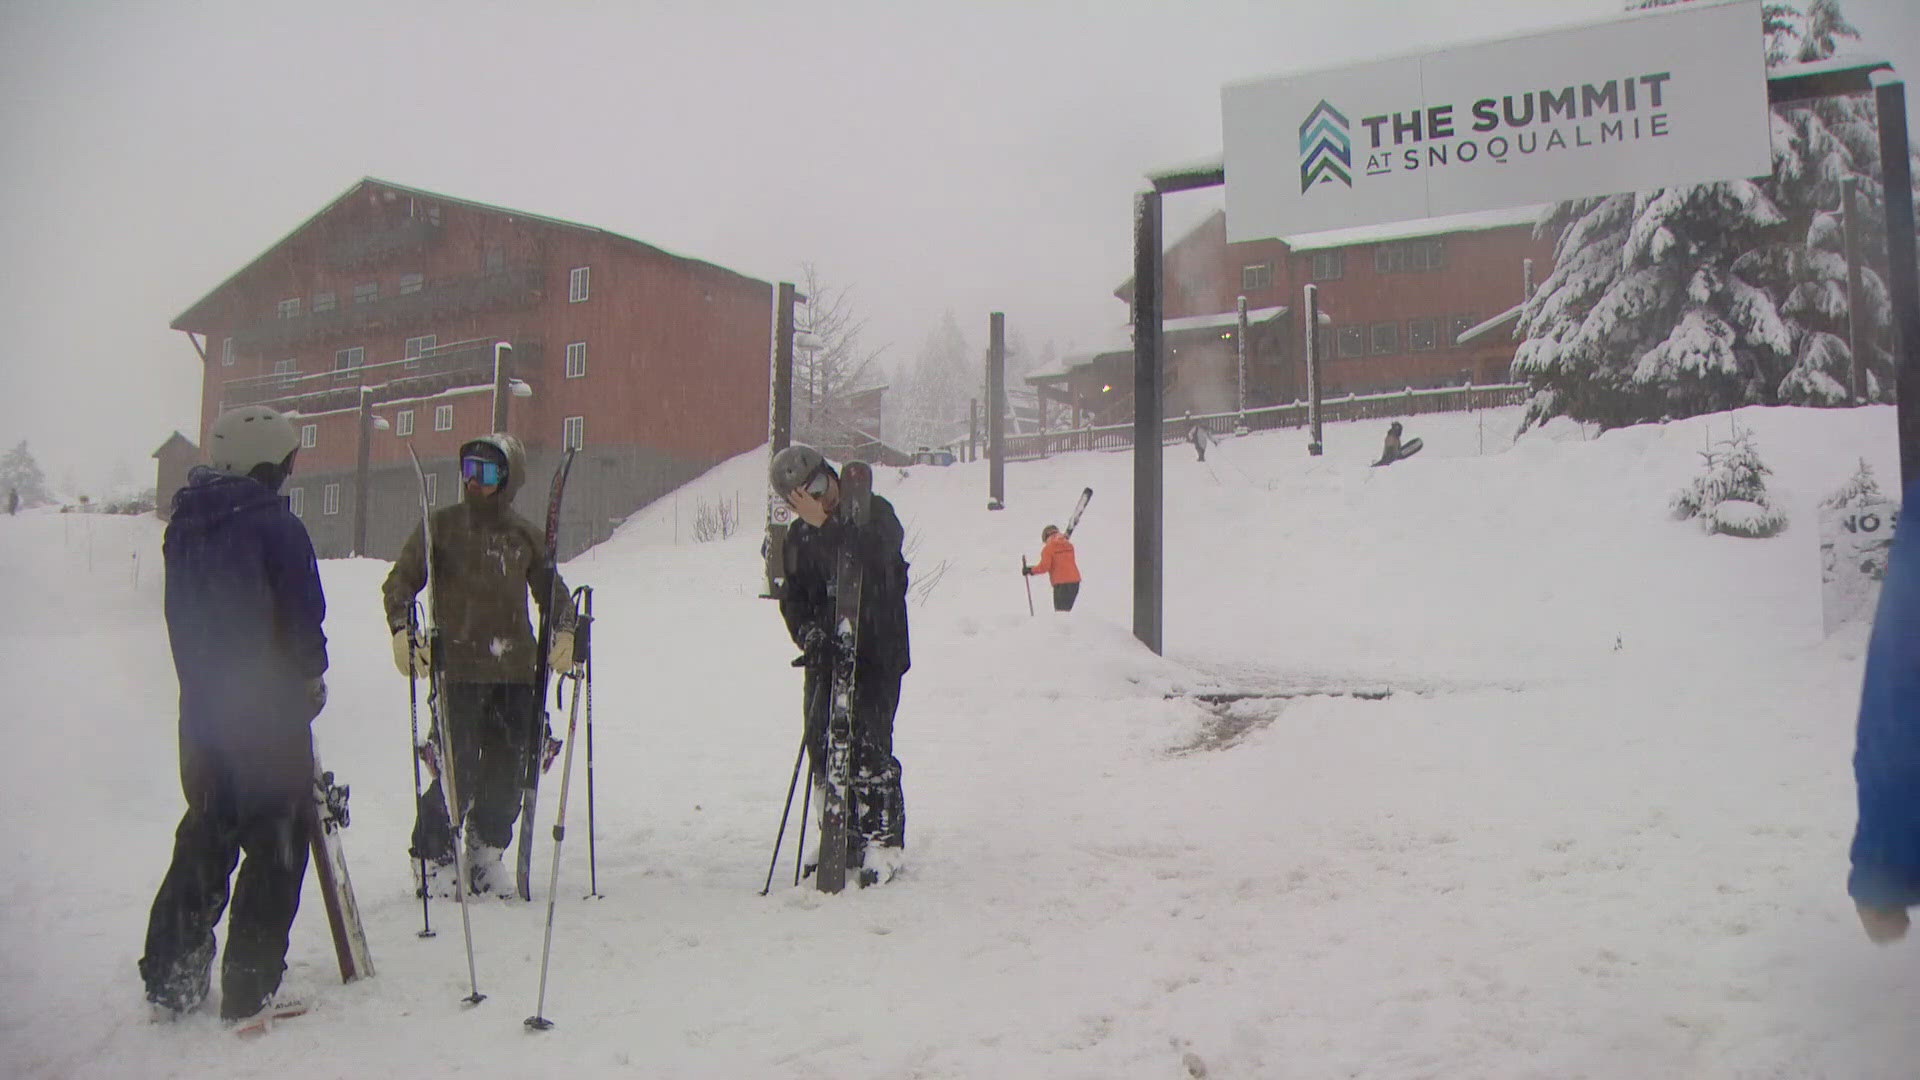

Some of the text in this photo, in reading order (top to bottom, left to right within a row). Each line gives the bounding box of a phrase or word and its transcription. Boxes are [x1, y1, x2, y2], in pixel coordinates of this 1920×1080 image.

[1361, 71, 1671, 149] THE SUMMIT
[1366, 113, 1670, 171] AT SNOQUALMIE
